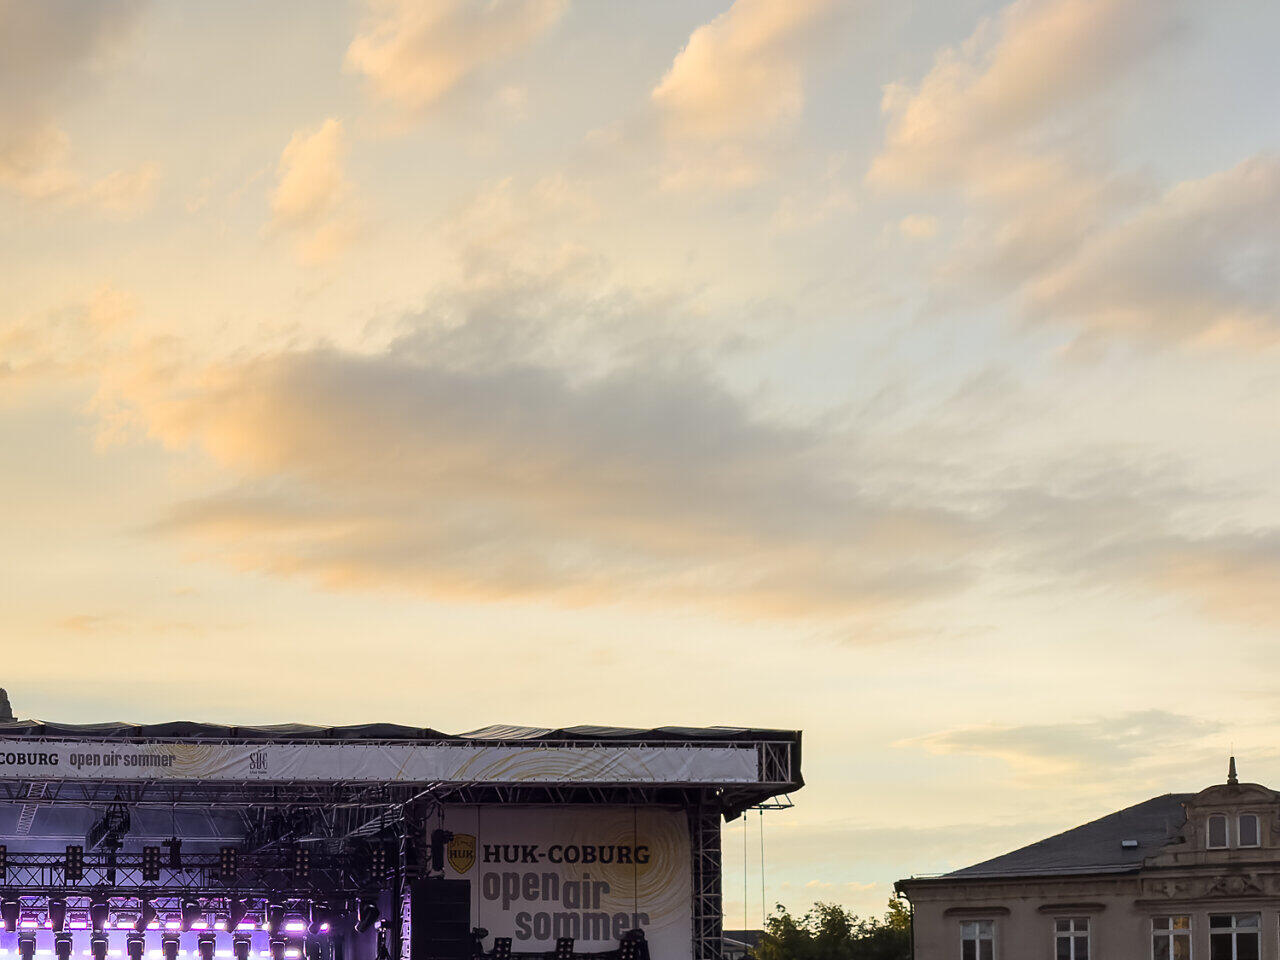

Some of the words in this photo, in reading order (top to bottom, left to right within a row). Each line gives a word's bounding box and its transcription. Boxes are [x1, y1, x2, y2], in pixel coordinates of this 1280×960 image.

[70, 752, 101, 769] open
[103, 751, 122, 767] air
[123, 753, 176, 767] sommer
[450, 850, 474, 858] HUK
[483, 844, 650, 865] HUK-COBURG
[482, 872, 560, 911] open
[562, 872, 611, 909] air
[515, 911, 650, 941] sommer
